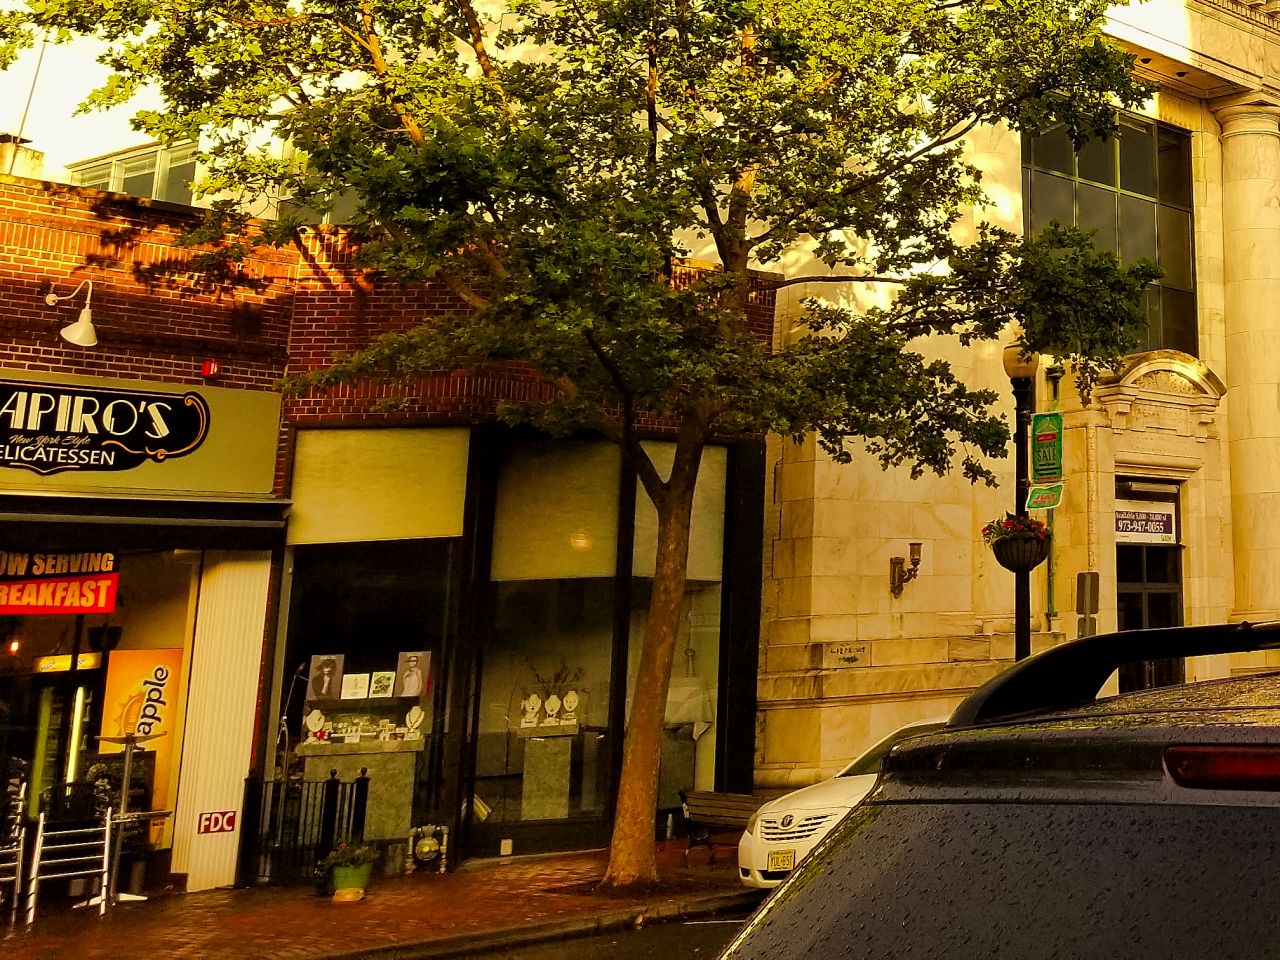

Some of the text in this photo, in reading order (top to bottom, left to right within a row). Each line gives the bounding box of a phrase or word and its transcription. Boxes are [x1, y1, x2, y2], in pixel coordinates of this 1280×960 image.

[9, 434, 91, 450] New York Style
[1118, 520, 1164, 532] 973-947-0055
[32, 552, 114, 575] SERVING
[135, 667, 169, 750] apple
[200, 812, 235, 833] FDC
